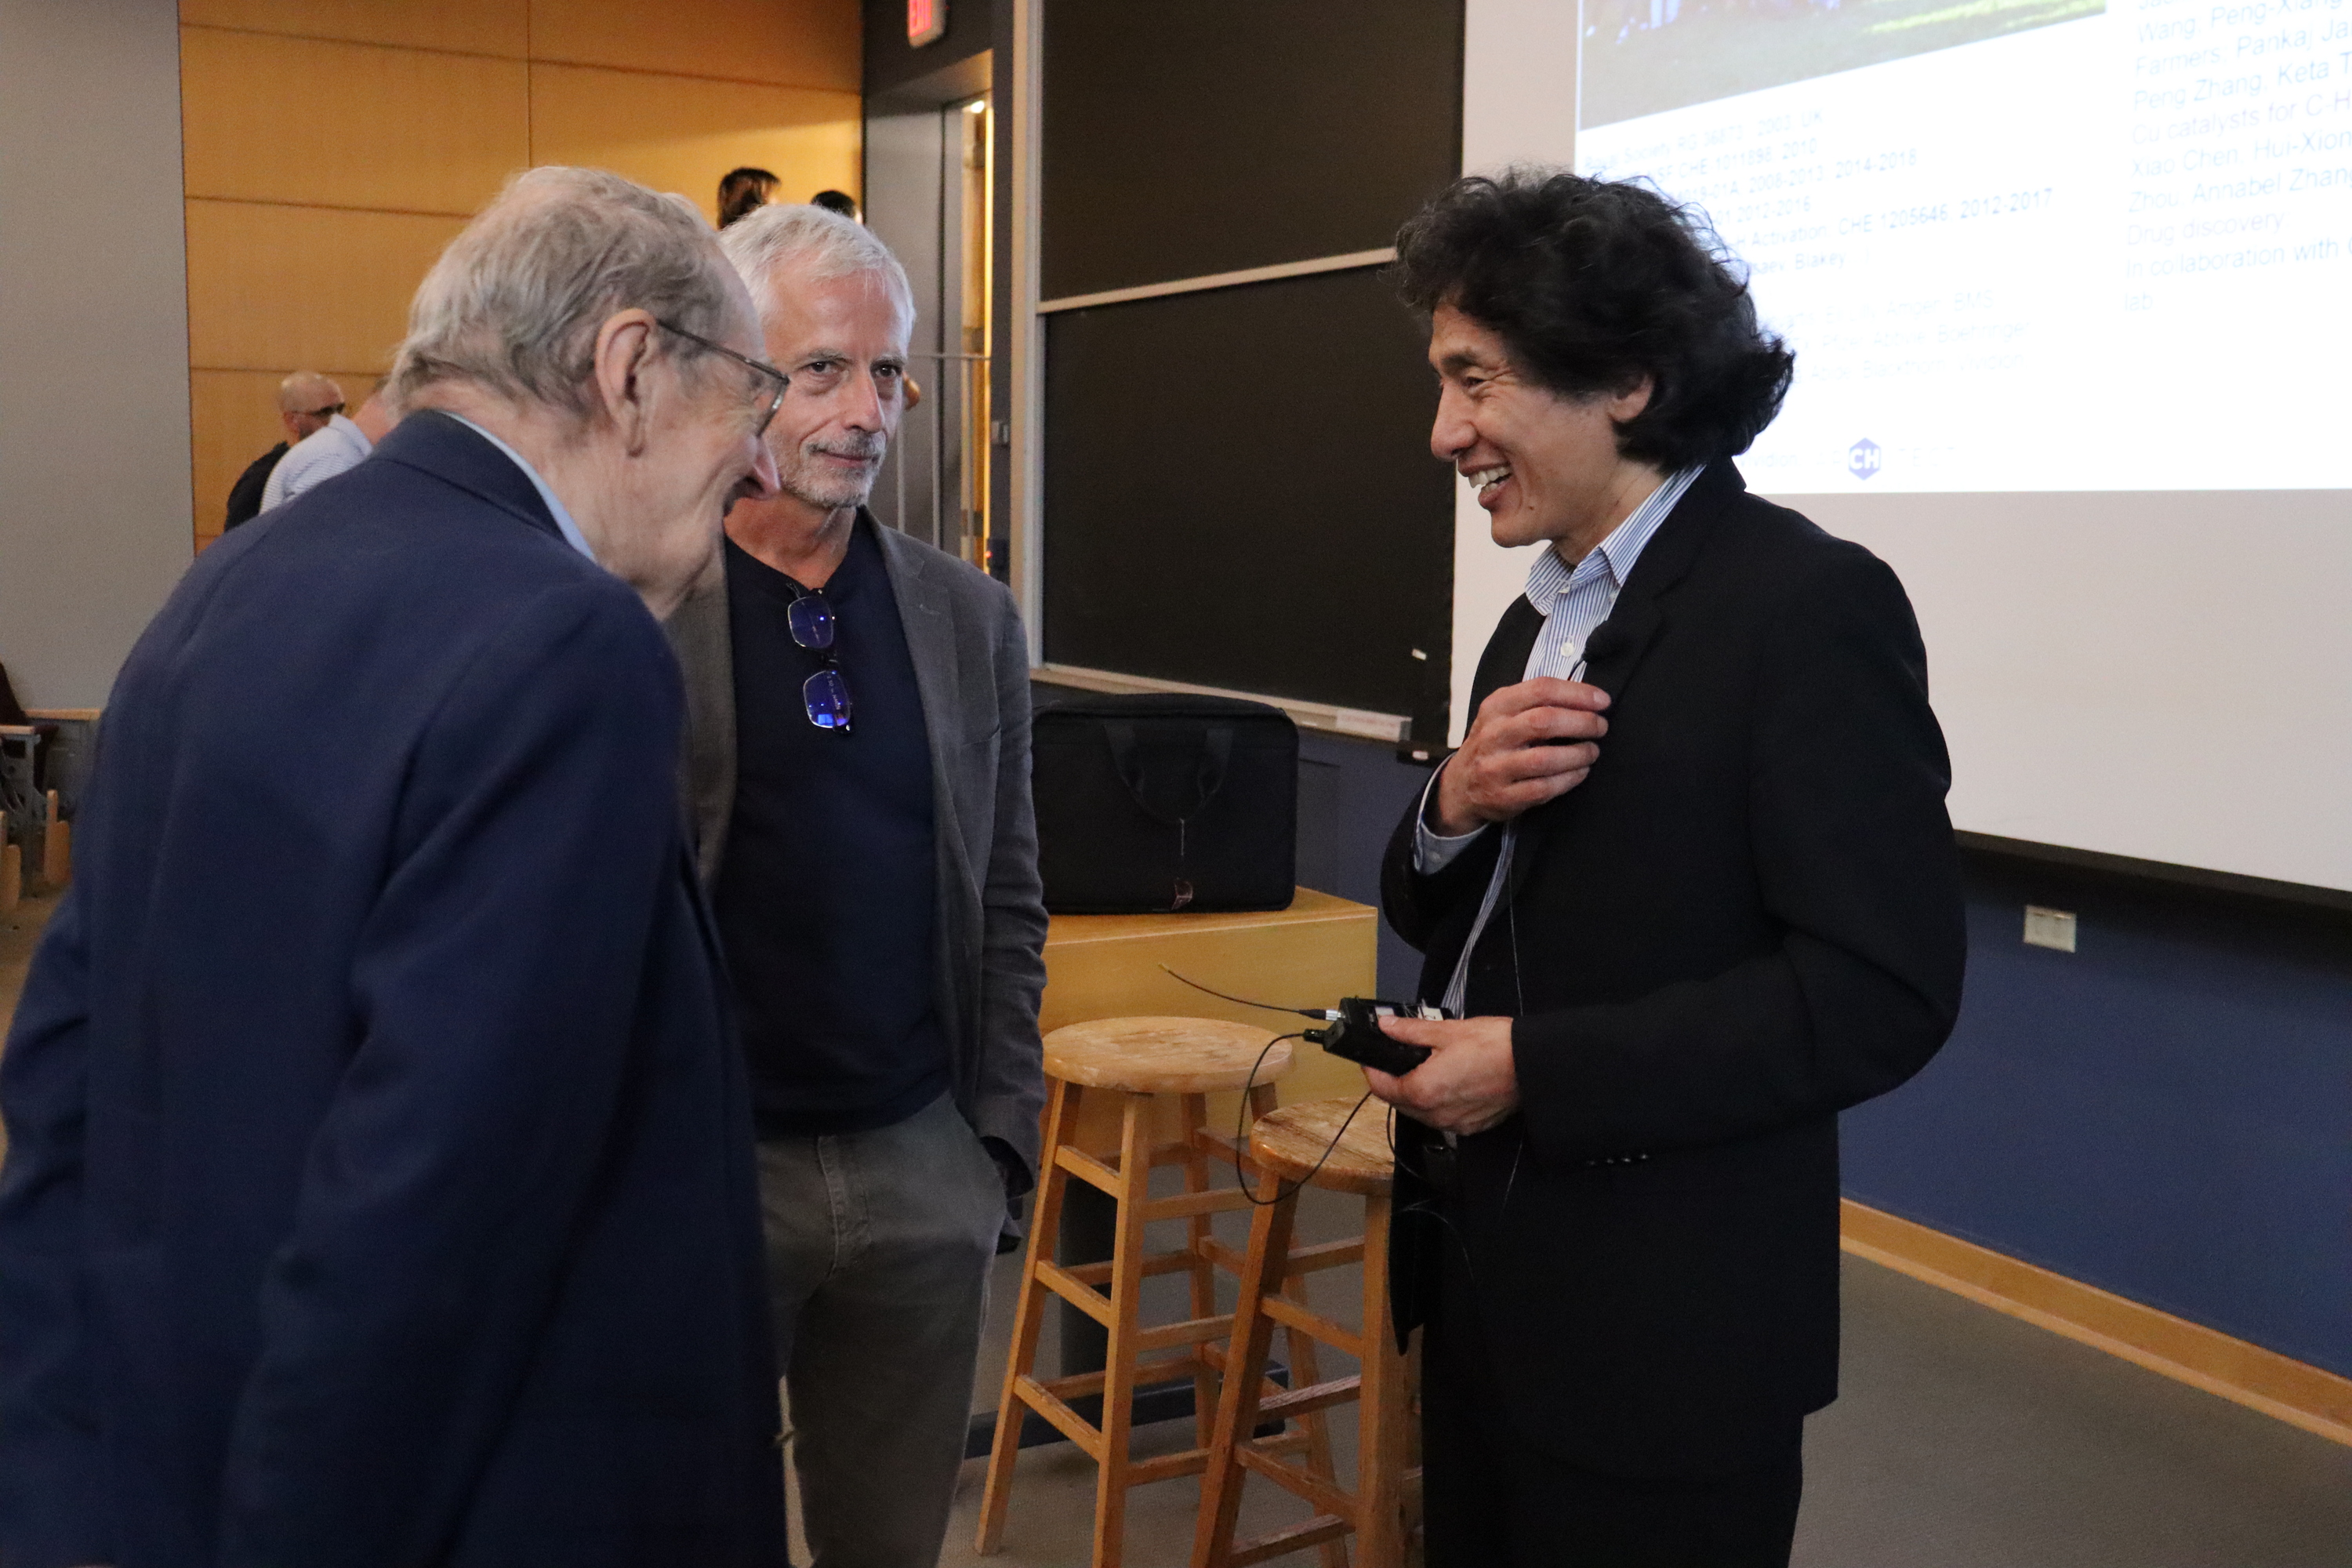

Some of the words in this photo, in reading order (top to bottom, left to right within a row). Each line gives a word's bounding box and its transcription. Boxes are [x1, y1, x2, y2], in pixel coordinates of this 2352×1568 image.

[2321, 18, 2352, 43] Ja
[2133, 87, 2186, 111] Peng
[2277, 60, 2330, 86] Keta
[2166, 107, 2260, 139] catalysts
[2268, 100, 2297, 123] for
[2192, 172, 2281, 204] Annabel
[2288, 166, 2352, 193] Zhan
[1838, 213, 1874, 236] CHE
[1960, 186, 2053, 220] 2012-2017
[2150, 245, 2285, 277] collaboration
[2292, 237, 2339, 263] with
